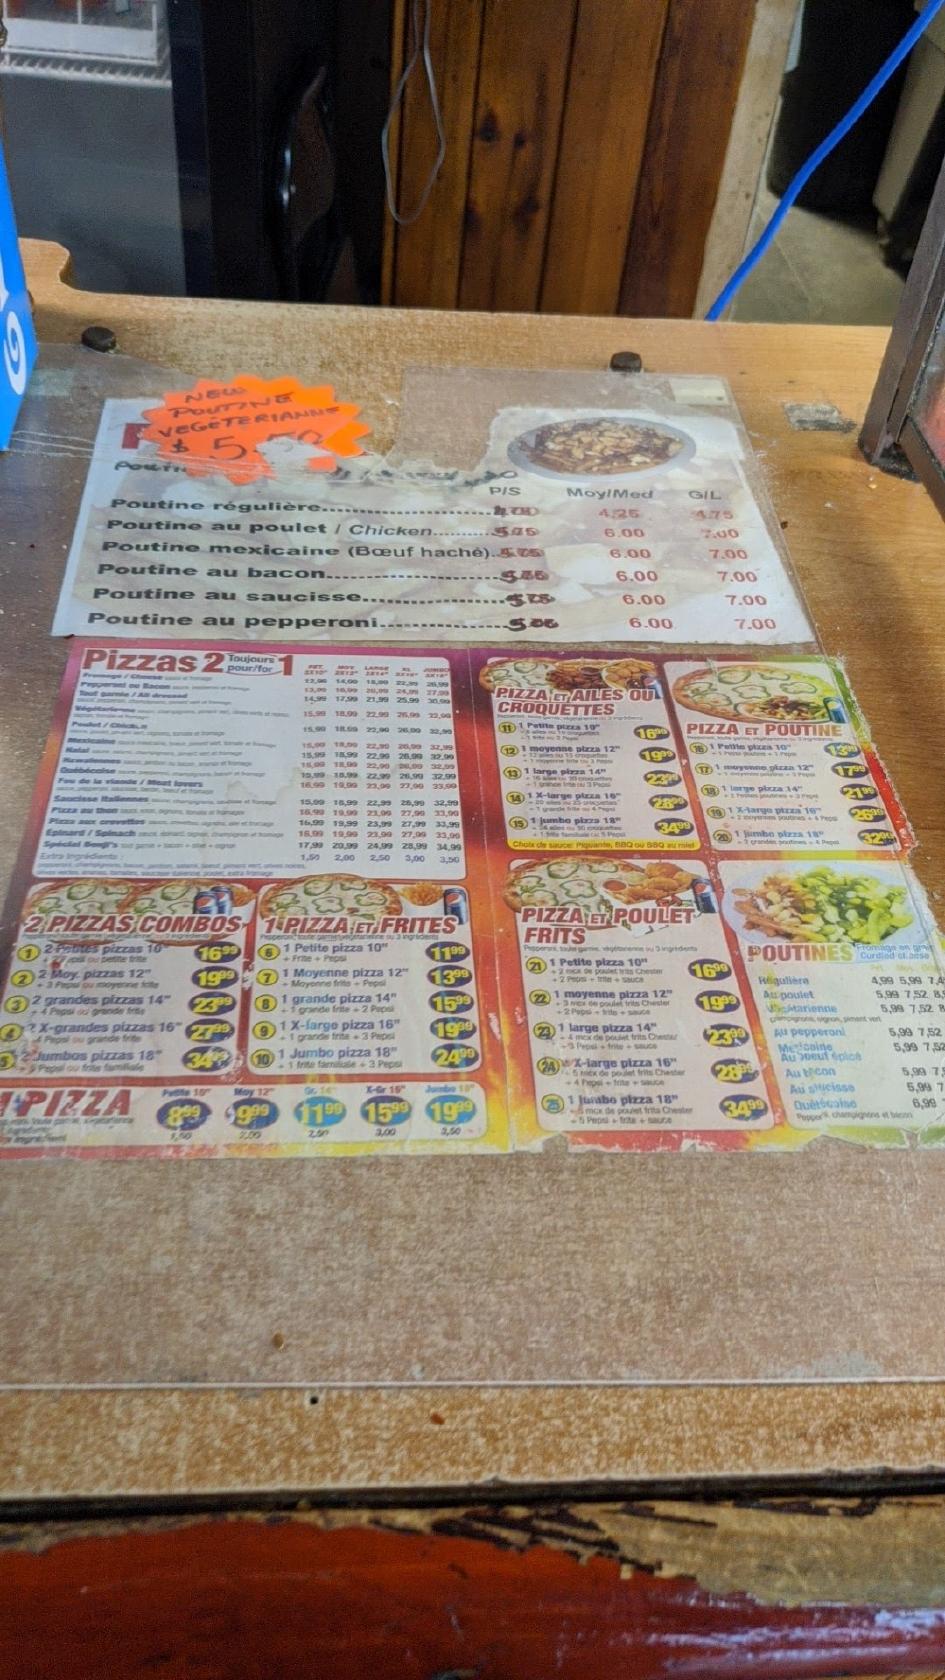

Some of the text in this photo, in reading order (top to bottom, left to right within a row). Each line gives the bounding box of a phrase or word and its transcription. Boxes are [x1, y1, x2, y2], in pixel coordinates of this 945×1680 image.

[185, 386, 247, 403] NEW
[169, 392, 295, 418] POUTINE
[489, 487, 721, 500] P/S Moy/Med G/L
[111, 499, 204, 510] Poutine
[599, 509, 640, 519] 4.25
[107, 520, 202, 530] Poutine
[211, 523, 241, 531] au
[250, 523, 327, 533] poulet
[349, 525, 432, 537] Chicken
[604, 529, 644, 538] 6.00
[704, 529, 739, 539] 7.00
[102, 542, 200, 552] Poutine
[209, 544, 340, 556] mexicaine
[348, 546, 413, 558] (Bœuf
[610, 549, 651, 559] 6.00
[709, 550, 747, 560] 7.00
[98, 564, 757, 582] Poutine au bacon 6.00 7.00
[93, 588, 195, 600] Poutine
[204, 592, 236, 601] au
[246, 591, 362, 602] saucisse
[623, 594, 665, 605] 6.00
[725, 595, 767, 605] 7.00
[88, 612, 776, 629] Poutine au pepperoni 6.00 7.00
[82, 650, 293, 676] Pizzas 2 1
[228, 655, 274, 664] Toujours
[228, 665, 272, 673] pour/for
[496, 688, 654, 702] PIZZA ET AILES OU
[498, 702, 614, 715] CROQUETTES
[687, 724, 738, 735] PIZZA
[766, 724, 842, 736] POUTINE
[540, 817, 599, 826] jumbo pizza
[437, 843, 461, 851] 34,99
[522, 908, 695, 924] PIZZA ET POULET
[25, 916, 242, 933] 2 PIZZAS COMBOS
[264, 917, 458, 933] 1 PIZZA ET FRITES
[525, 928, 585, 944] FRITS
[102, 945, 144, 955] pizzas
[295, 943, 329, 952] Petite
[332, 945, 363, 954] pizza
[748, 944, 853, 961] POUTINES
[560, 958, 593, 967] Petite
[596, 959, 625, 968] pizza
[84, 970, 124, 980] pizzas
[294, 969, 348, 979] Moyenne
[353, 968, 384, 979] pizza
[872, 977, 922, 985] 4,99 5,99
[293, 995, 335, 1004] grande
[339, 994, 371, 1004] pizza
[564, 991, 615, 1000] moyenne
[619, 991, 649, 1000] pizza
[781, 991, 928, 999] poulet 5,99 7,52
[32, 996, 39, 1005] 2
[44, 997, 98, 1007] grandes
[102, 997, 143, 1007] pizzas
[39, 1024, 108, 1034] X-grandes
[112, 1023, 153, 1034] pizzas
[291, 1020, 338, 1032] X-large
[342, 1021, 375, 1031] pizza
[569, 1023, 598, 1034] large
[602, 1023, 633, 1034] pizza
[889, 1028, 913, 1037] 5,99
[918, 1028, 941, 1037] 7,52
[894, 1043, 918, 1052] 5,99
[91, 1051, 133, 1062] pizzas
[290, 1048, 333, 1059] Jumbo
[338, 1048, 372, 1059] pizza
[574, 1058, 617, 1068] X-large
[621, 1058, 652, 1069] pizza
[17, 1089, 131, 1116] PIZZA
[621, 1094, 653, 1105] pizza
